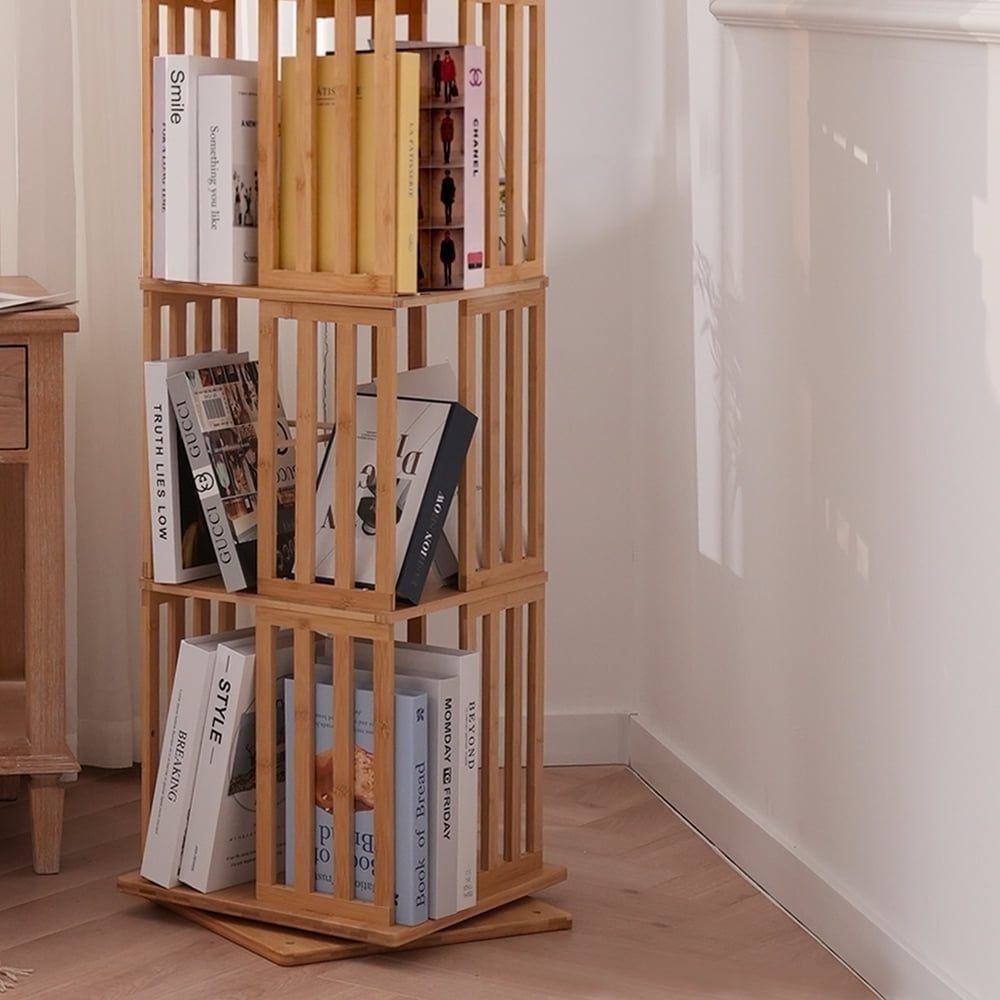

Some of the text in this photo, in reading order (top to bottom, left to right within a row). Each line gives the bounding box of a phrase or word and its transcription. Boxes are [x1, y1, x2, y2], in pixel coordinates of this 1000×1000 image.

[170, 69, 185, 125] Smile
[208, 125, 220, 231] Something you like
[472, 118, 480, 177] CHANEL
[176, 400, 201, 458] GUCCI
[153, 404, 168, 541] TRUTH LIES LOW
[206, 506, 232, 565] GUCCI
[210, 678, 231, 744] STYLE
[444, 698, 452, 762] MOMDAY
[468, 701, 476, 770] BEYOND
[167, 730, 188, 803] BREAKING
[415, 762, 426, 908] Book of Bread
[443, 787, 451, 840] FRIDAY
